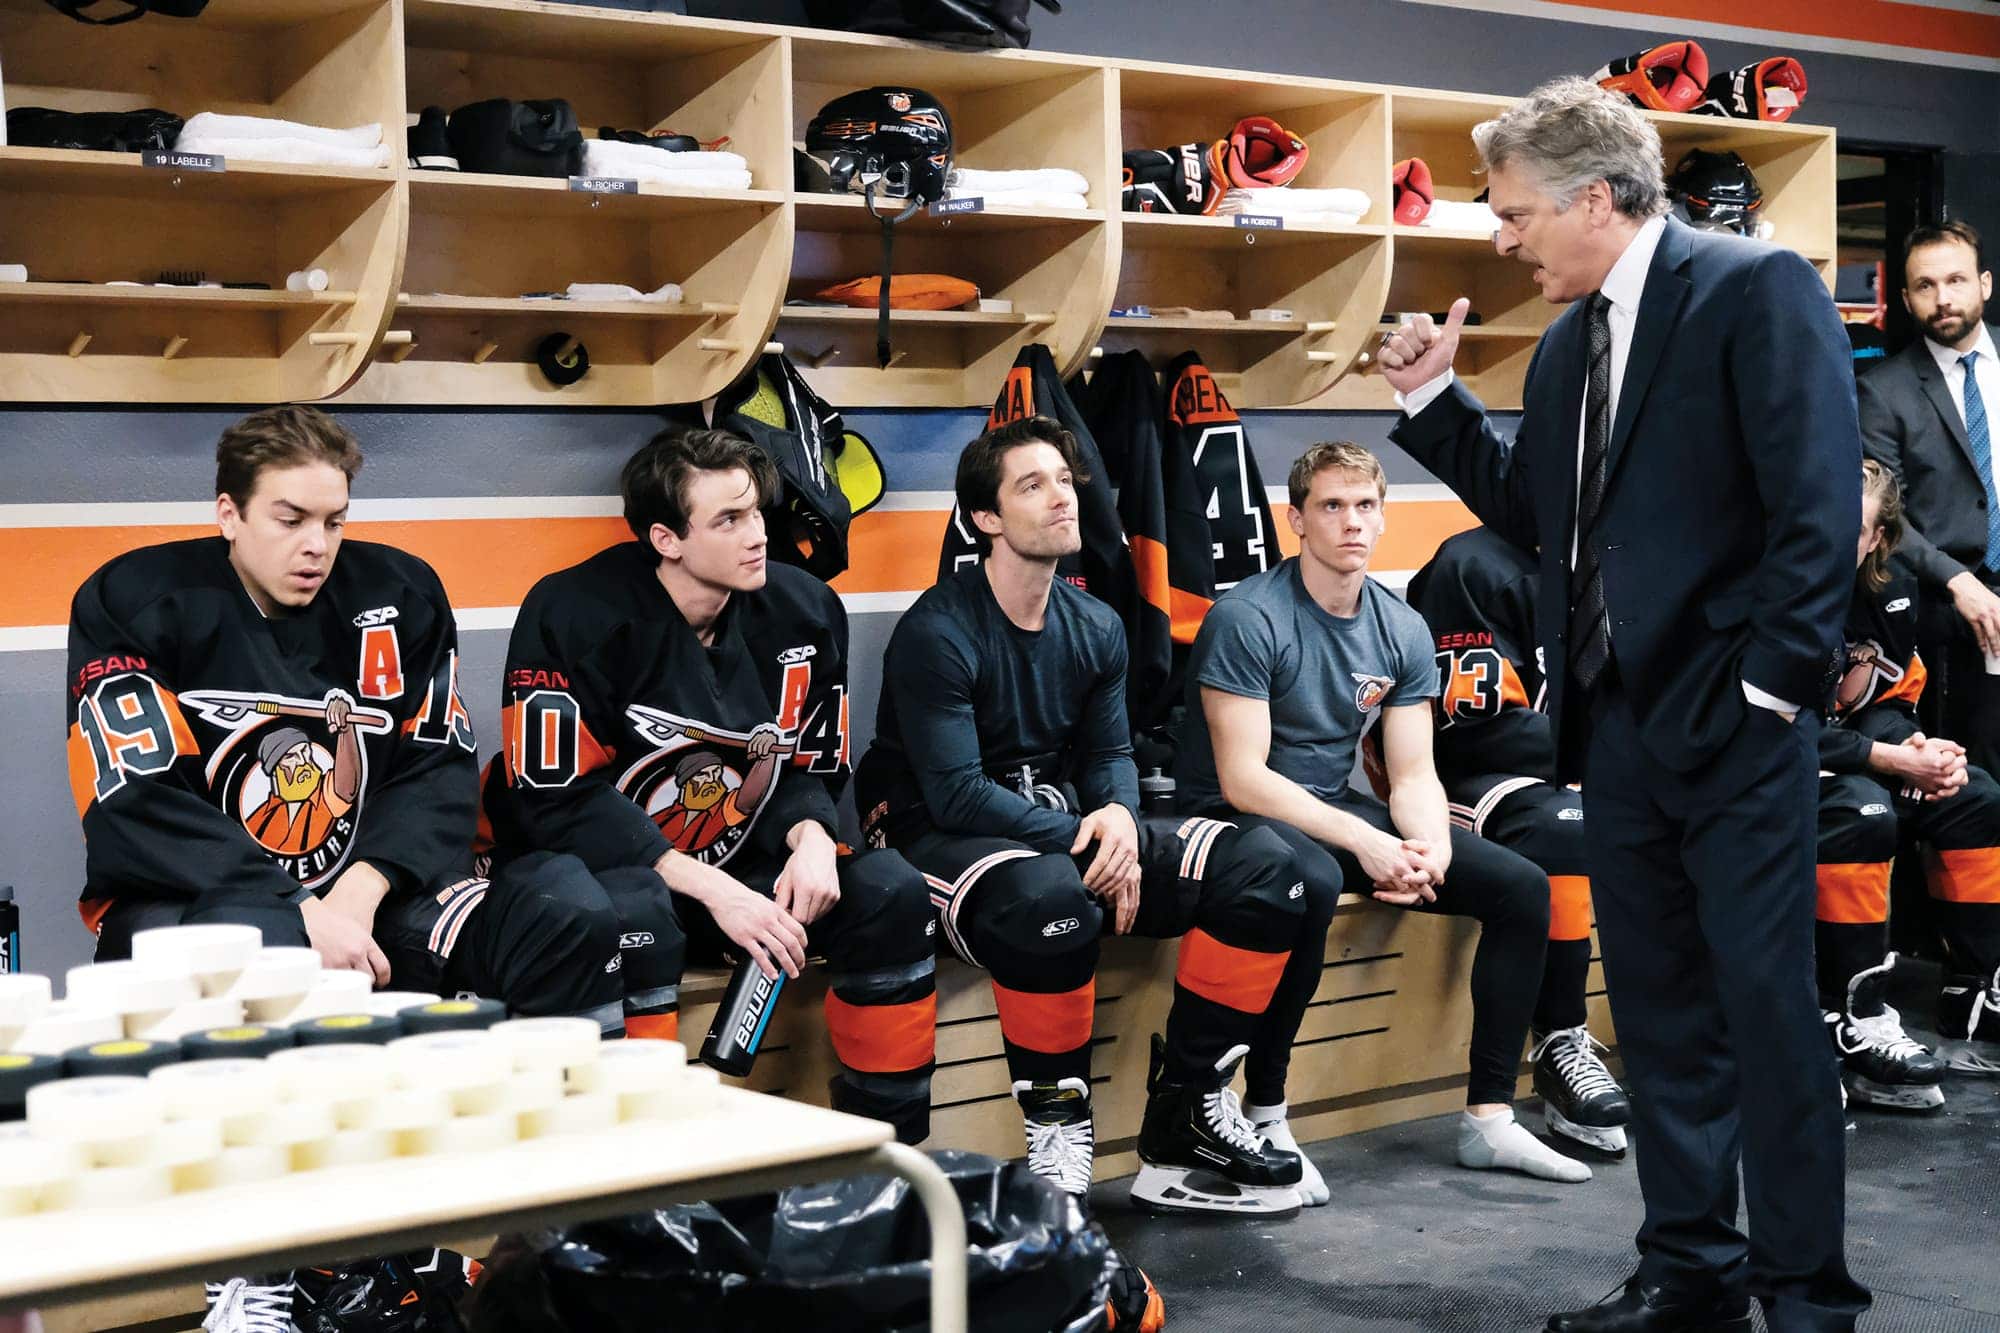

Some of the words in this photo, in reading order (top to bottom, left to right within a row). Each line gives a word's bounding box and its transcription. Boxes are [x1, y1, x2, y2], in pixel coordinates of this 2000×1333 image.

[155, 155, 168, 165] 19
[171, 155, 213, 168] LABELLE
[1180, 143, 1203, 203] UER
[595, 180, 625, 191] RICHER
[948, 201, 975, 211] WALKER
[1250, 217, 1278, 228] ROBERTS
[356, 624, 405, 700] A
[1434, 647, 1504, 731] 13
[78, 671, 179, 804] 19
